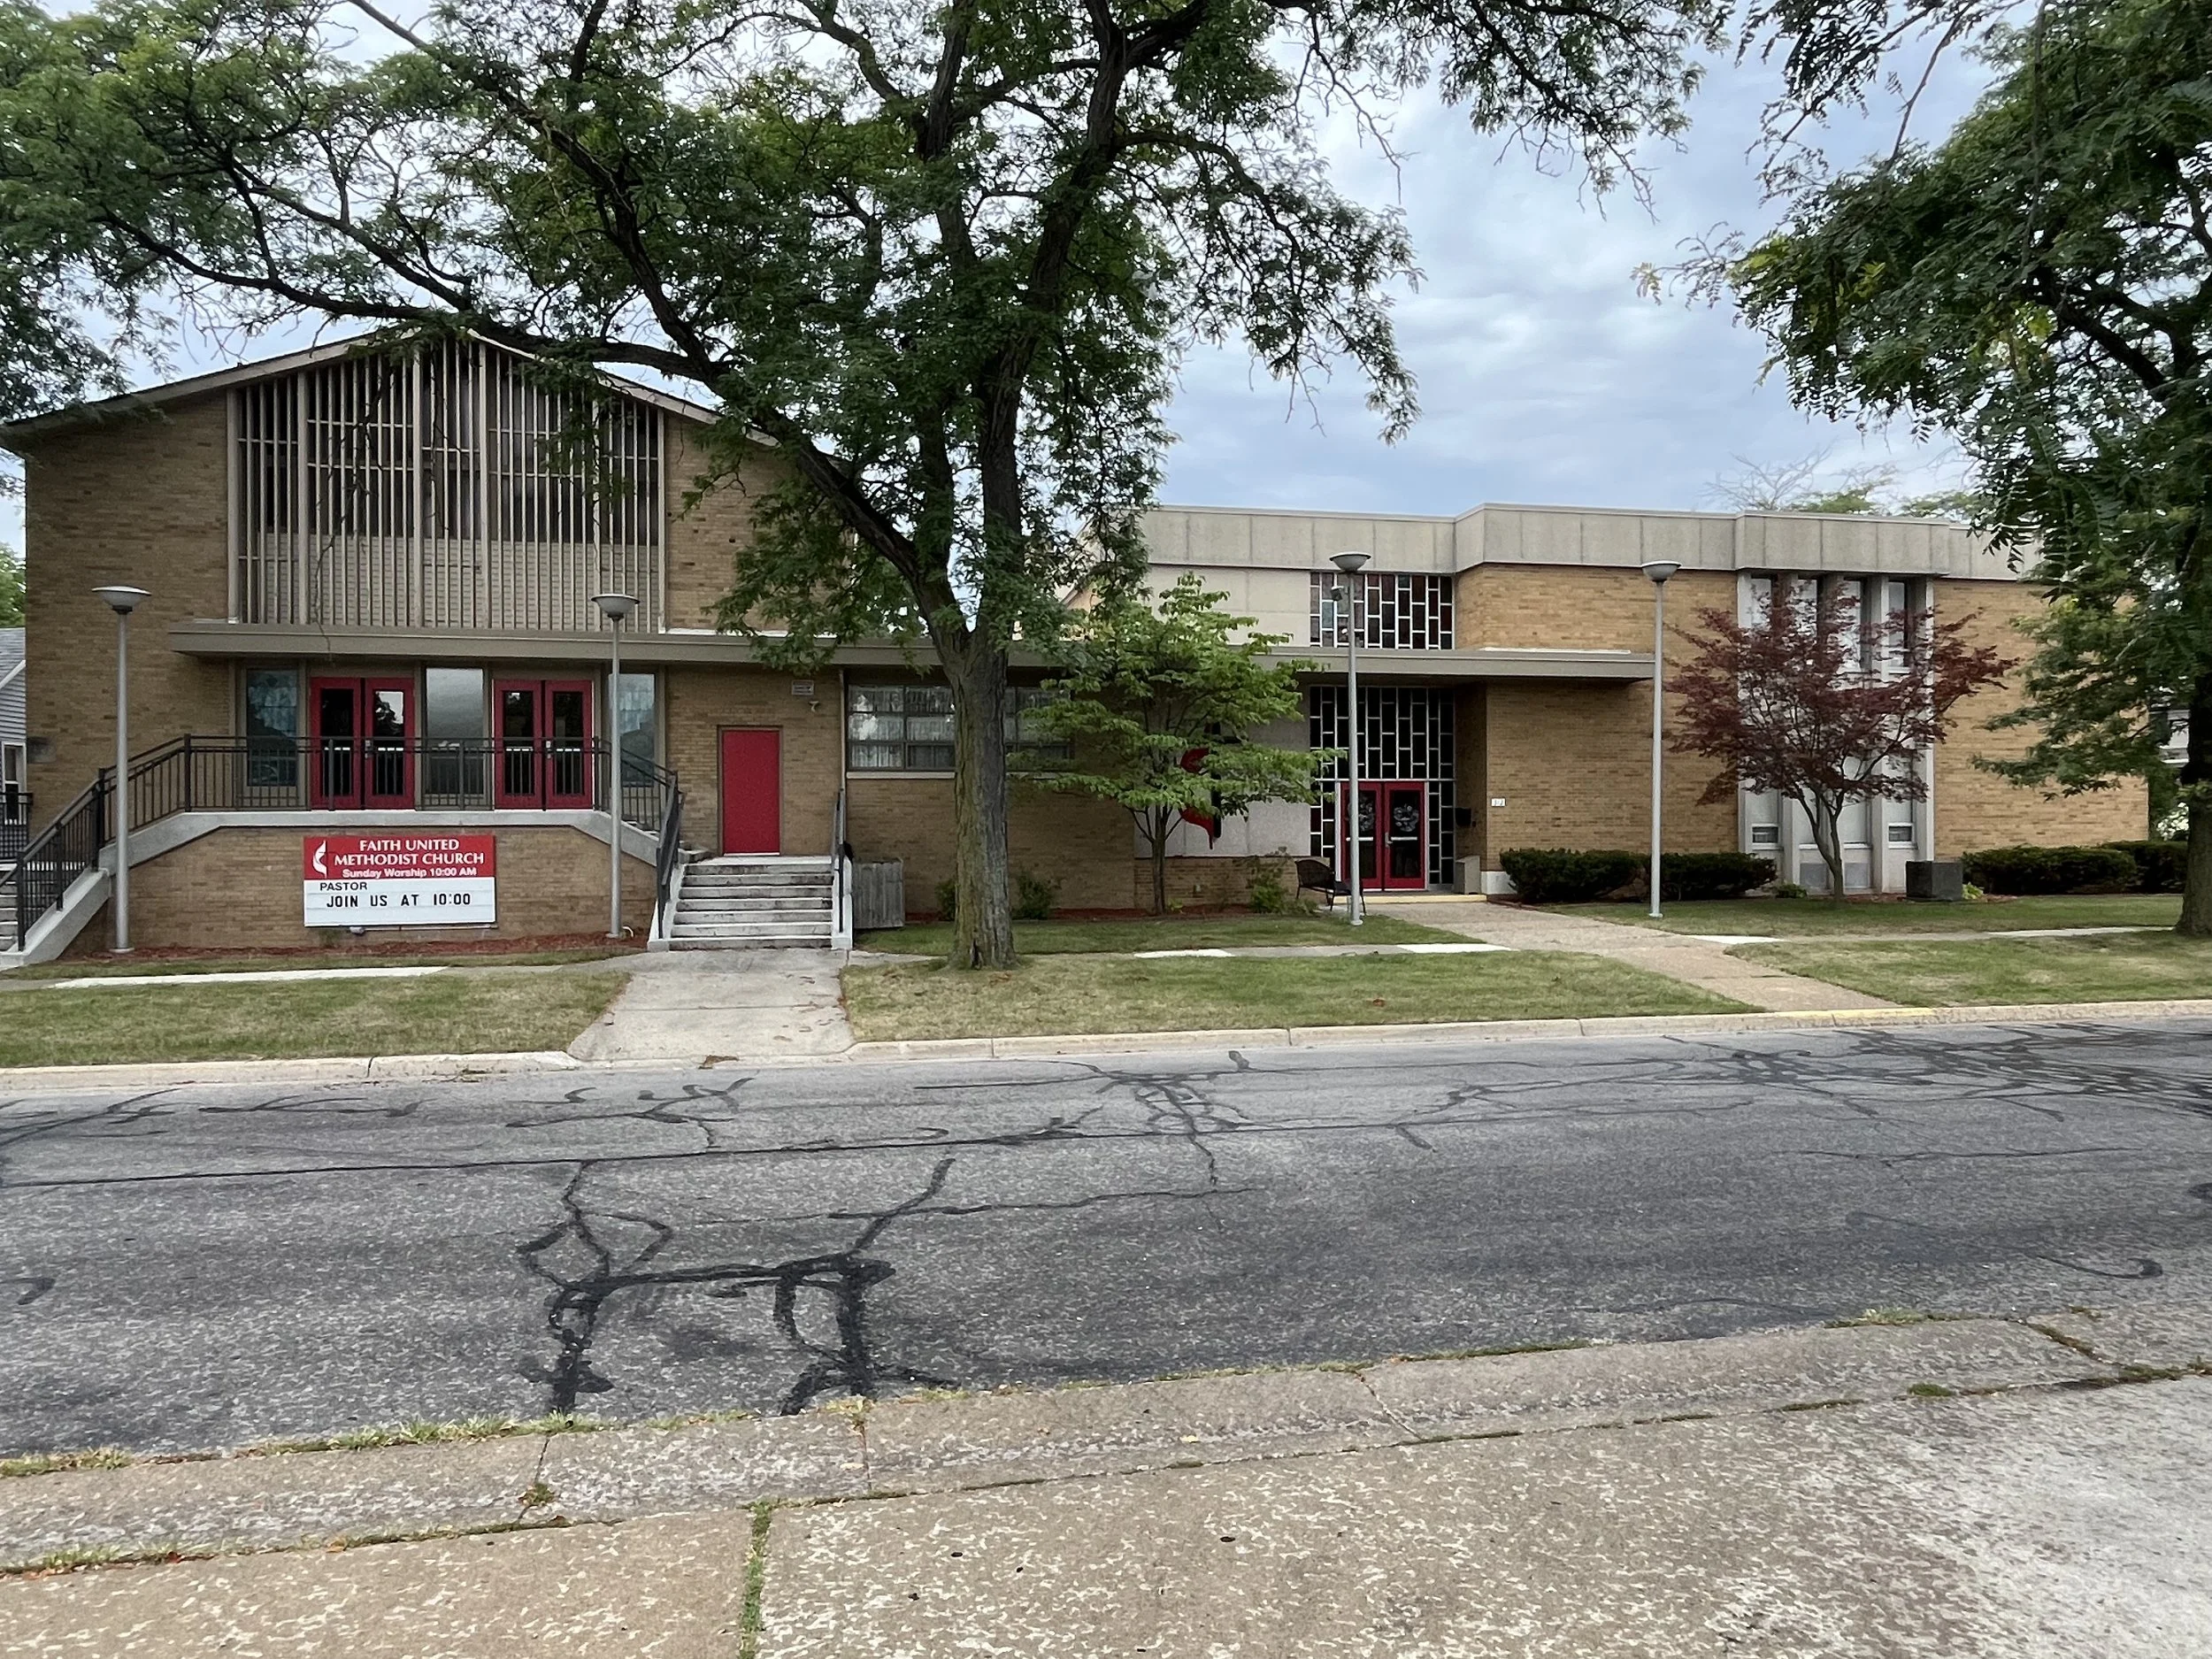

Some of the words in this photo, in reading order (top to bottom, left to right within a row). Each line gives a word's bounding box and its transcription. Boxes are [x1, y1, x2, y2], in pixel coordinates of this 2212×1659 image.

[359, 840, 401, 851] FAITH
[405, 840, 460, 851] UNITED
[334, 854, 418, 865] METHODIST
[422, 852, 483, 864] CHURCH
[342, 868, 381, 879] Sunday
[384, 868, 426, 878] Worship
[429, 867, 457, 876] 10:00
[459, 867, 477, 876] AM
[319, 882, 368, 891] PASTOR
[326, 895, 358, 908] JOIN
[370, 895, 388, 907] US
[401, 894, 419, 906] AT
[434, 893, 471, 905] 10:00
